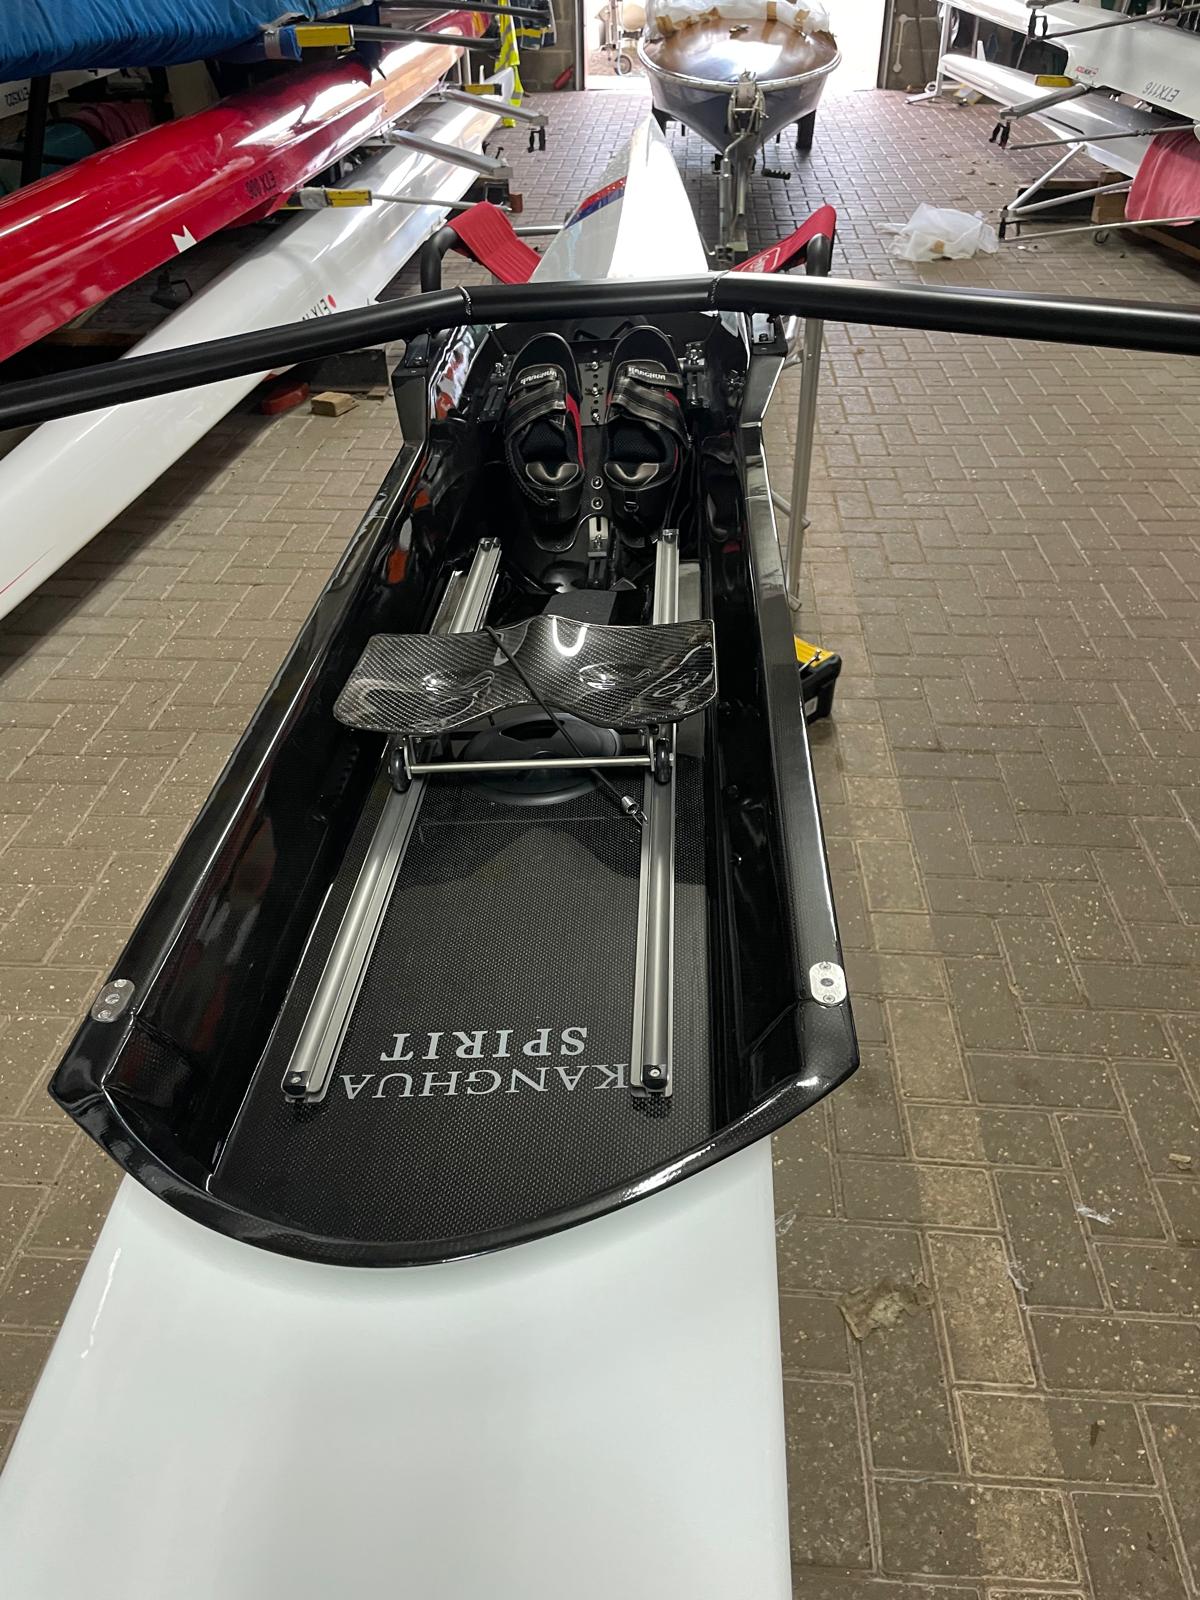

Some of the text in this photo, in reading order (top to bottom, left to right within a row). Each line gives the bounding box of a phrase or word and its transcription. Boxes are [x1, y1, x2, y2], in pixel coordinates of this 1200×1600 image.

[1142, 81, 1180, 102] ETX116
[380, 1027, 588, 1061] SPIRIT
[340, 1063, 629, 1100] KANGHUA
